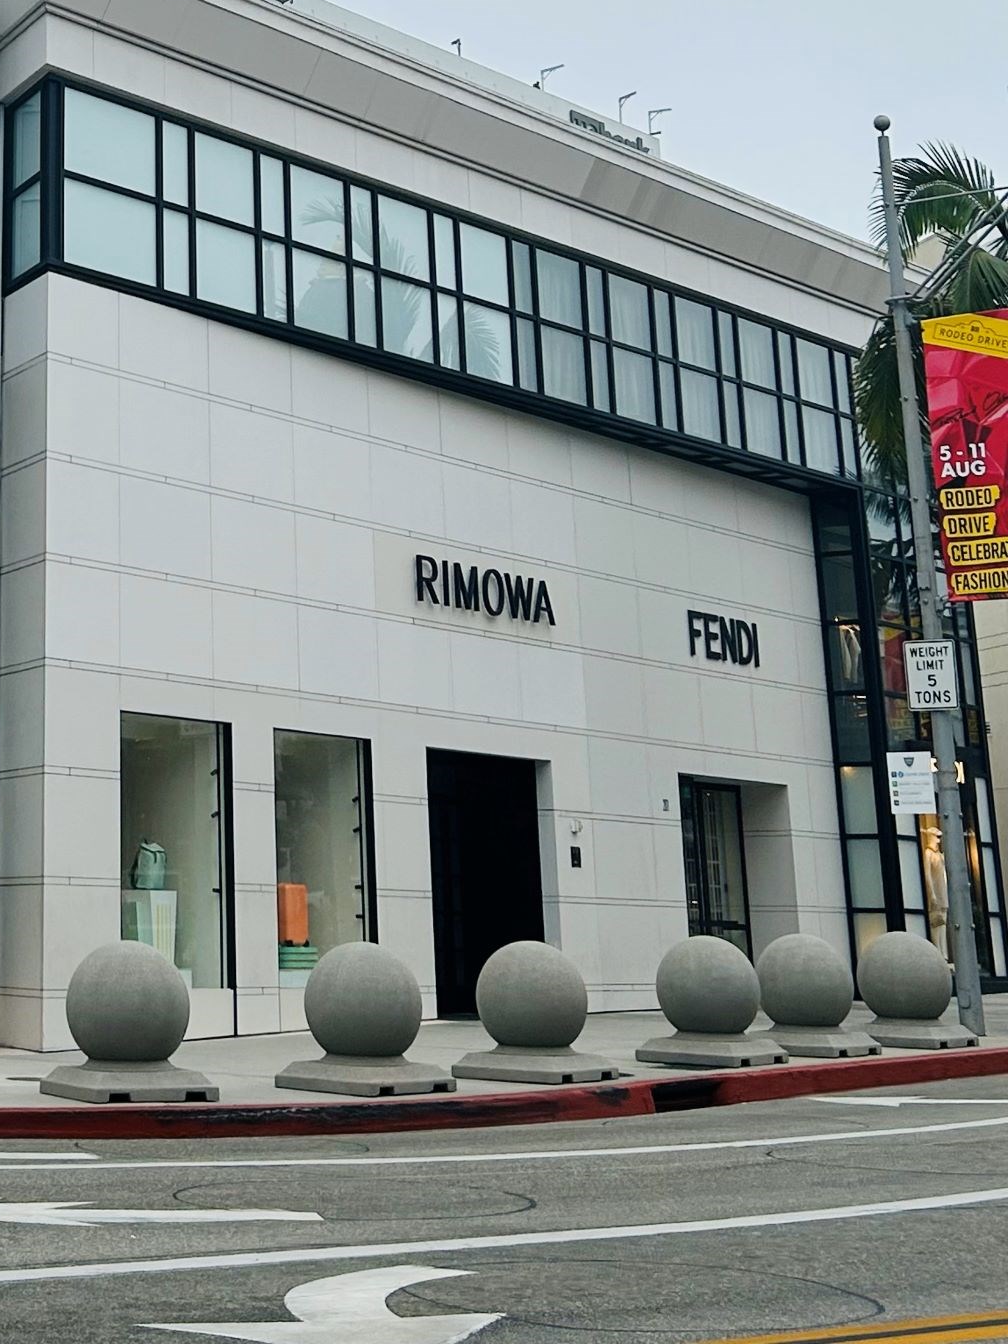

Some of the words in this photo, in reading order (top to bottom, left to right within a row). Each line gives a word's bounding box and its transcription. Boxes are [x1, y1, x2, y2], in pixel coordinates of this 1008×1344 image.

[939, 328, 974, 342] RODEO
[977, 336, 1008, 349] DRIVE
[940, 445, 952, 461] 5
[969, 442, 986, 459] 11
[941, 459, 986, 478] AUG
[945, 487, 992, 507] RODEO
[948, 515, 990, 535] DRIVE
[415, 554, 556, 626] RIMOWA
[954, 570, 1008, 591] FASHION
[687, 609, 760, 668] FENDI
[909, 646, 949, 658] WEIGHT
[916, 659, 944, 671] LIMIT
[927, 674, 937, 687] 5
[915, 690, 951, 704] TONS
